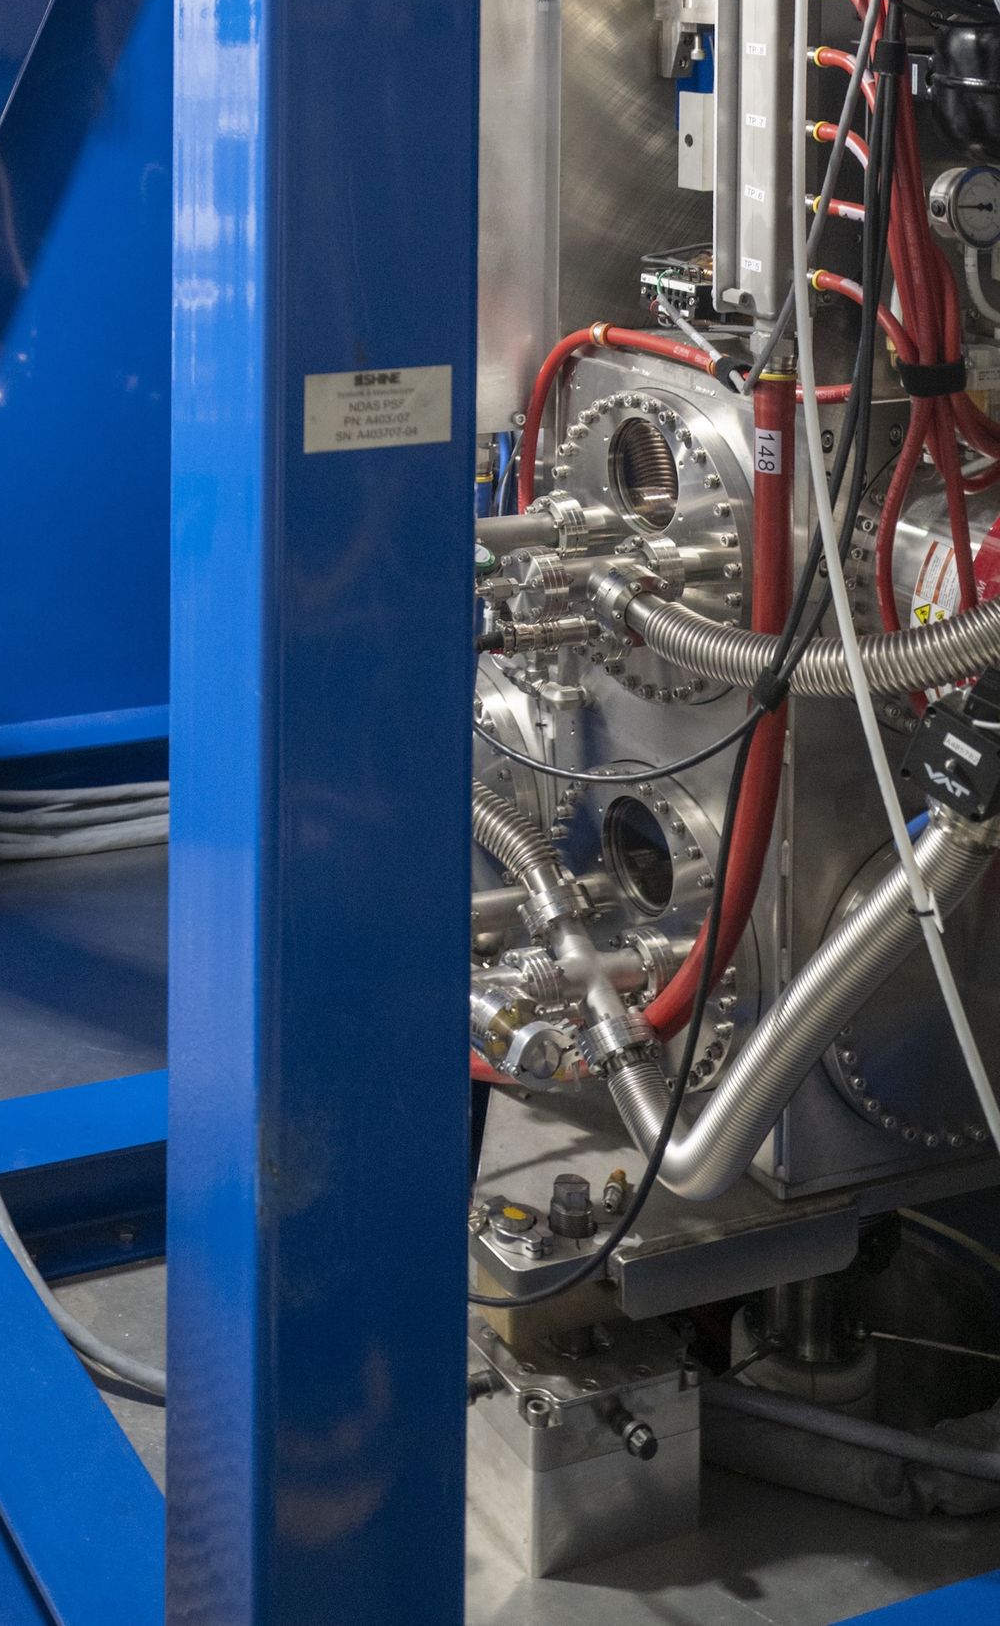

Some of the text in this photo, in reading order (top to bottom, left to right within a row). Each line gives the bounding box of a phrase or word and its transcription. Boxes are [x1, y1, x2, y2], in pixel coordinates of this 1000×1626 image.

[362, 372, 401, 385] SHINE
[349, 400, 381, 412] NDAS
[758, 434, 775, 471] 148
[924, 762, 970, 797] VAT
